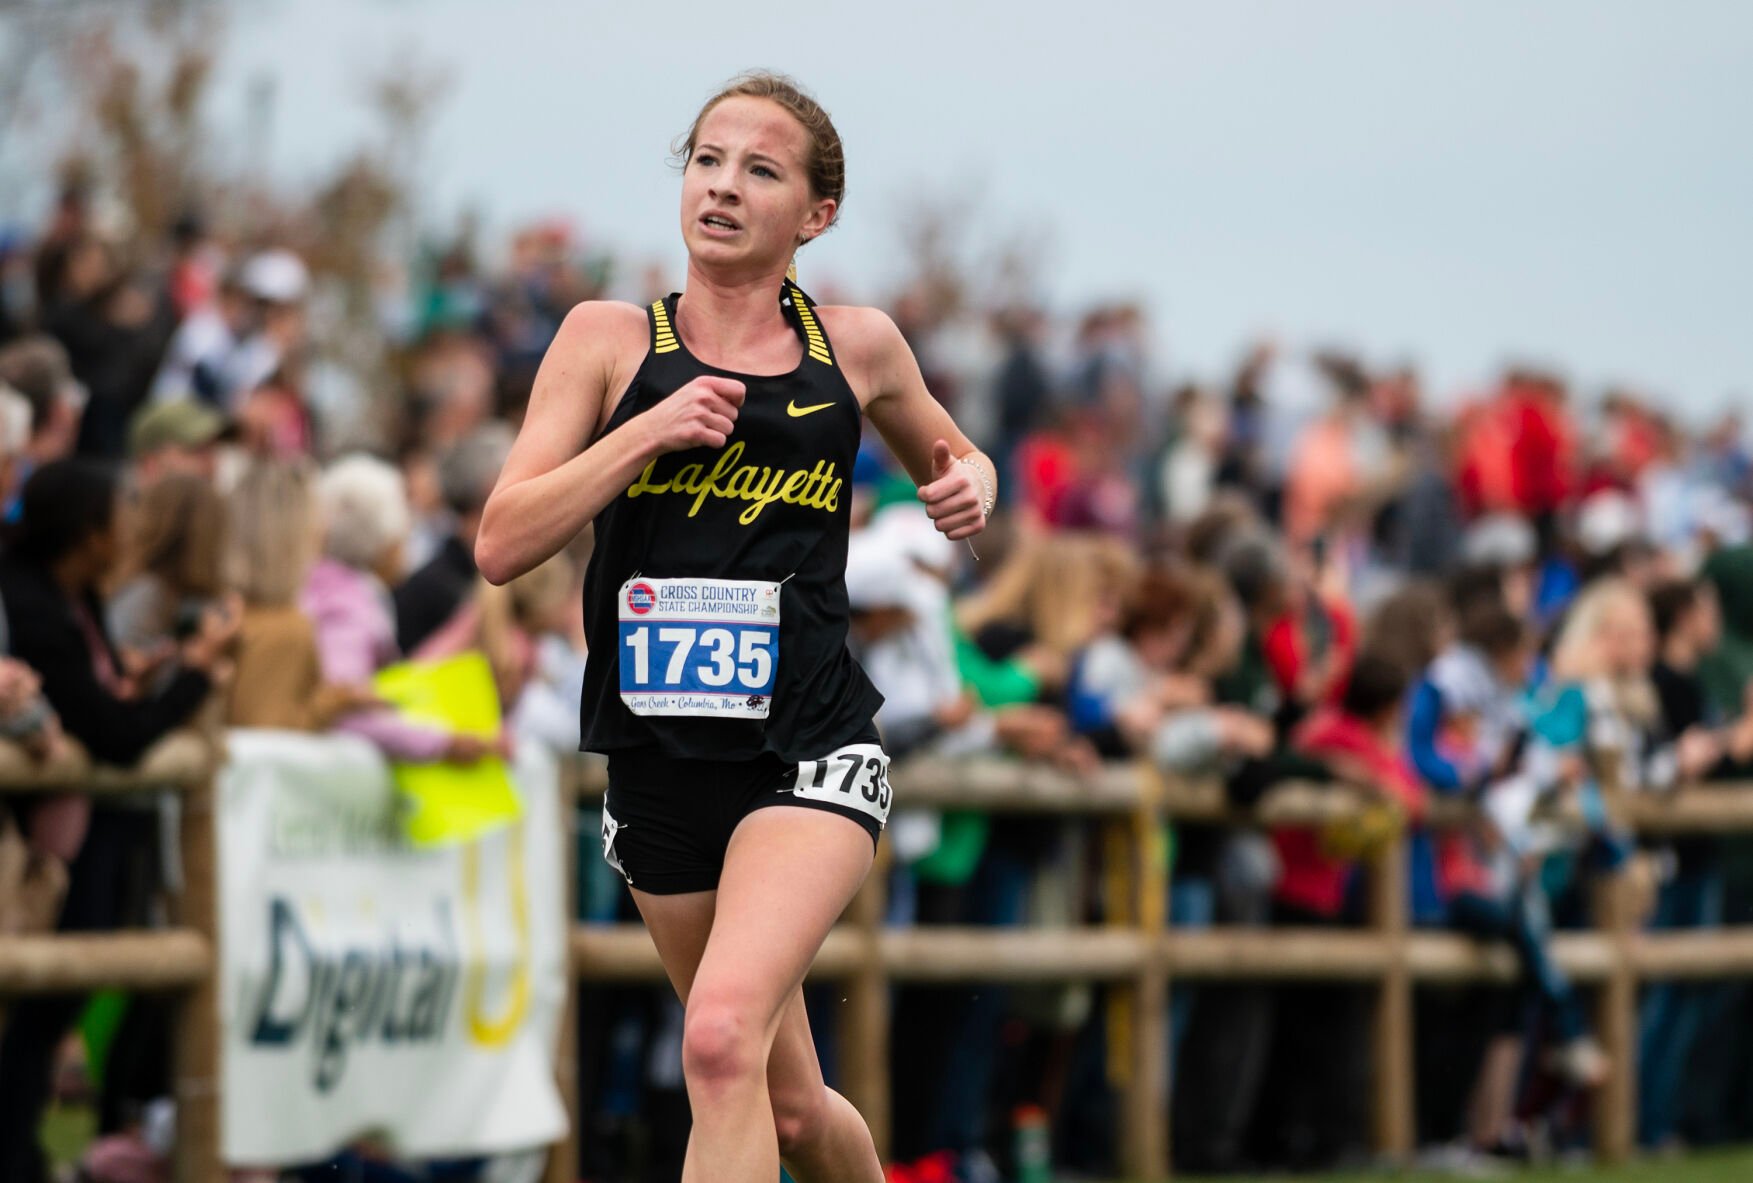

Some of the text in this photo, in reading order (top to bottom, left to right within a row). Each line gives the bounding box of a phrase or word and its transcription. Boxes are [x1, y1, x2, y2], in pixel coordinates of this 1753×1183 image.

[627, 440, 843, 526] Lafayette
[658, 601, 685, 612] STATE
[688, 601, 759, 615] CHAMPIONSHIP
[660, 585, 757, 602] CROSS COUNTRY
[626, 627, 772, 688] 1735
[648, 696, 669, 709] Creek
[721, 698, 736, 710] Mo
[812, 753, 890, 809] 1735
[249, 895, 460, 1096] Digital
